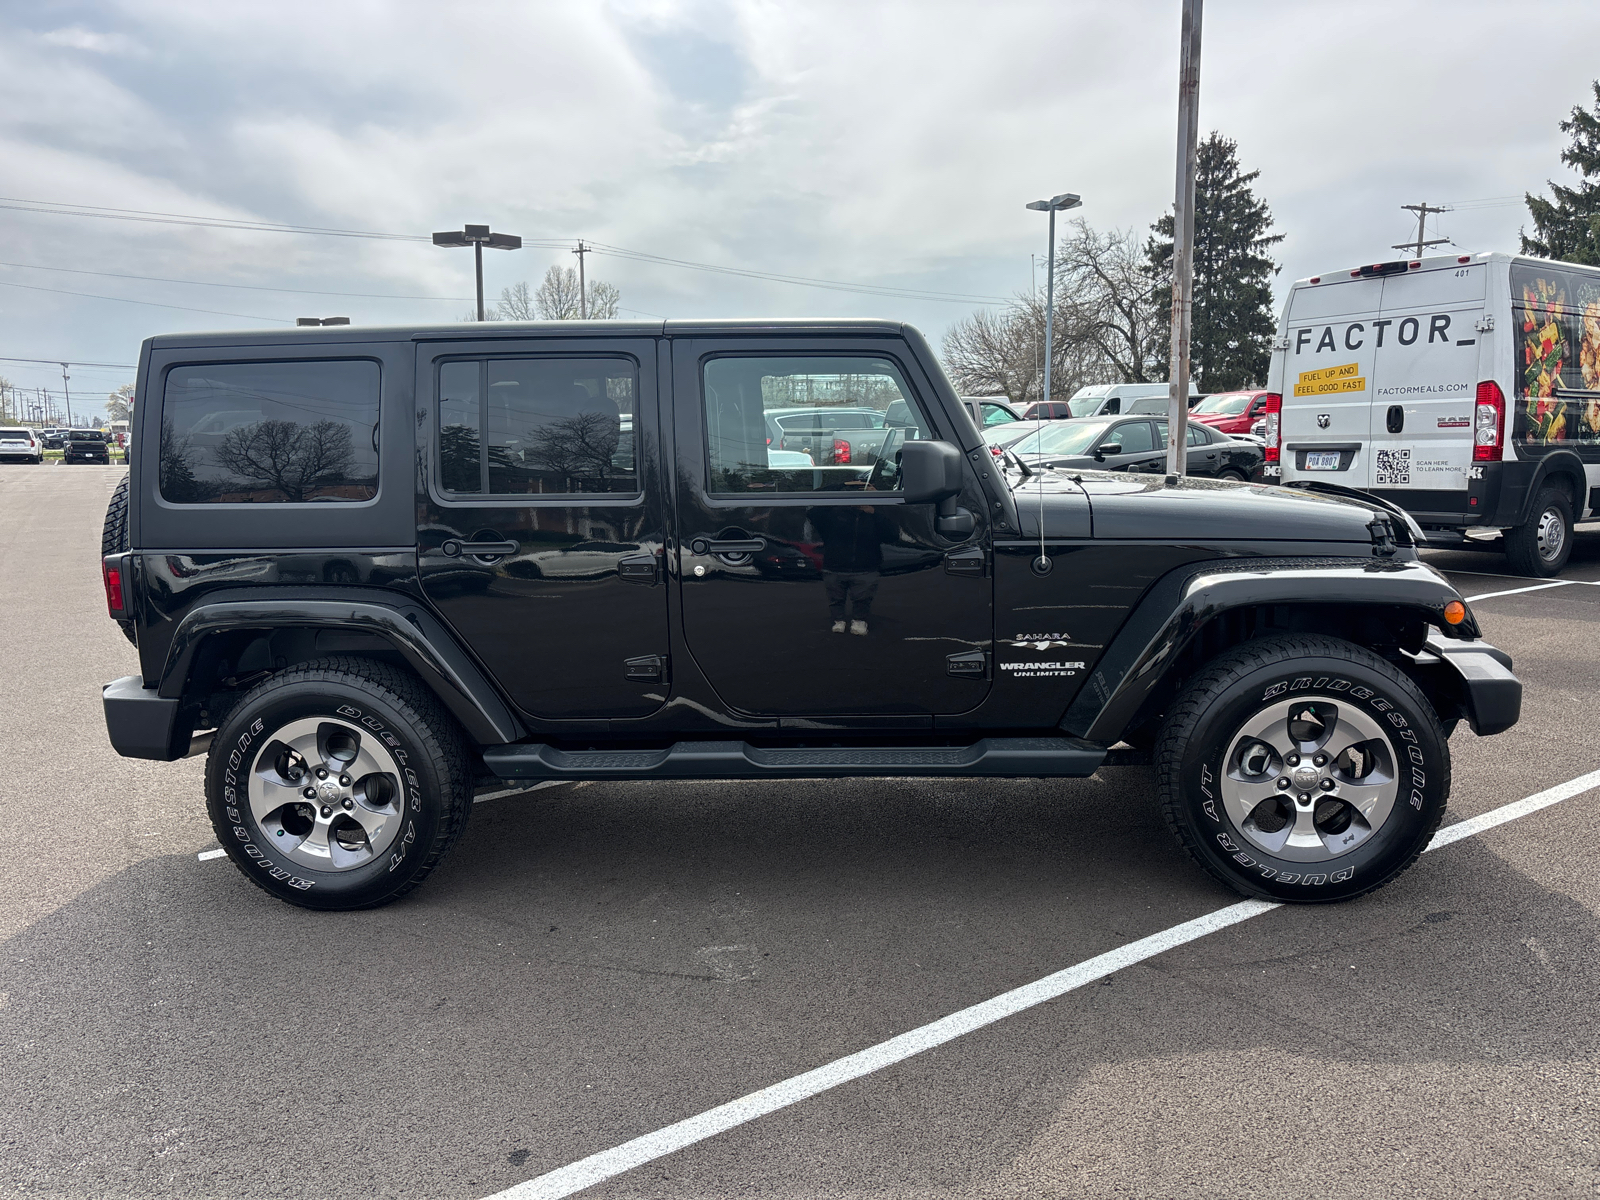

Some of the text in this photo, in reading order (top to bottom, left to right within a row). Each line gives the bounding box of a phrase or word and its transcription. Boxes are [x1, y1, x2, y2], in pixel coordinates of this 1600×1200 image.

[1455, 269, 1469, 277] 401
[1303, 367, 1354, 382] FUEL UP AND
[1297, 381, 1362, 394] FEEL GOOD FAST
[1377, 384, 1468, 396] FACTORMEALS.COM
[1016, 633, 1071, 641] SAHARA
[1000, 662, 1085, 670] WRANGLER
[1263, 676, 1426, 811] BRIDGESTONE
[224, 718, 316, 891] BRIDGESTONE
[1216, 832, 1355, 886] DUELER
